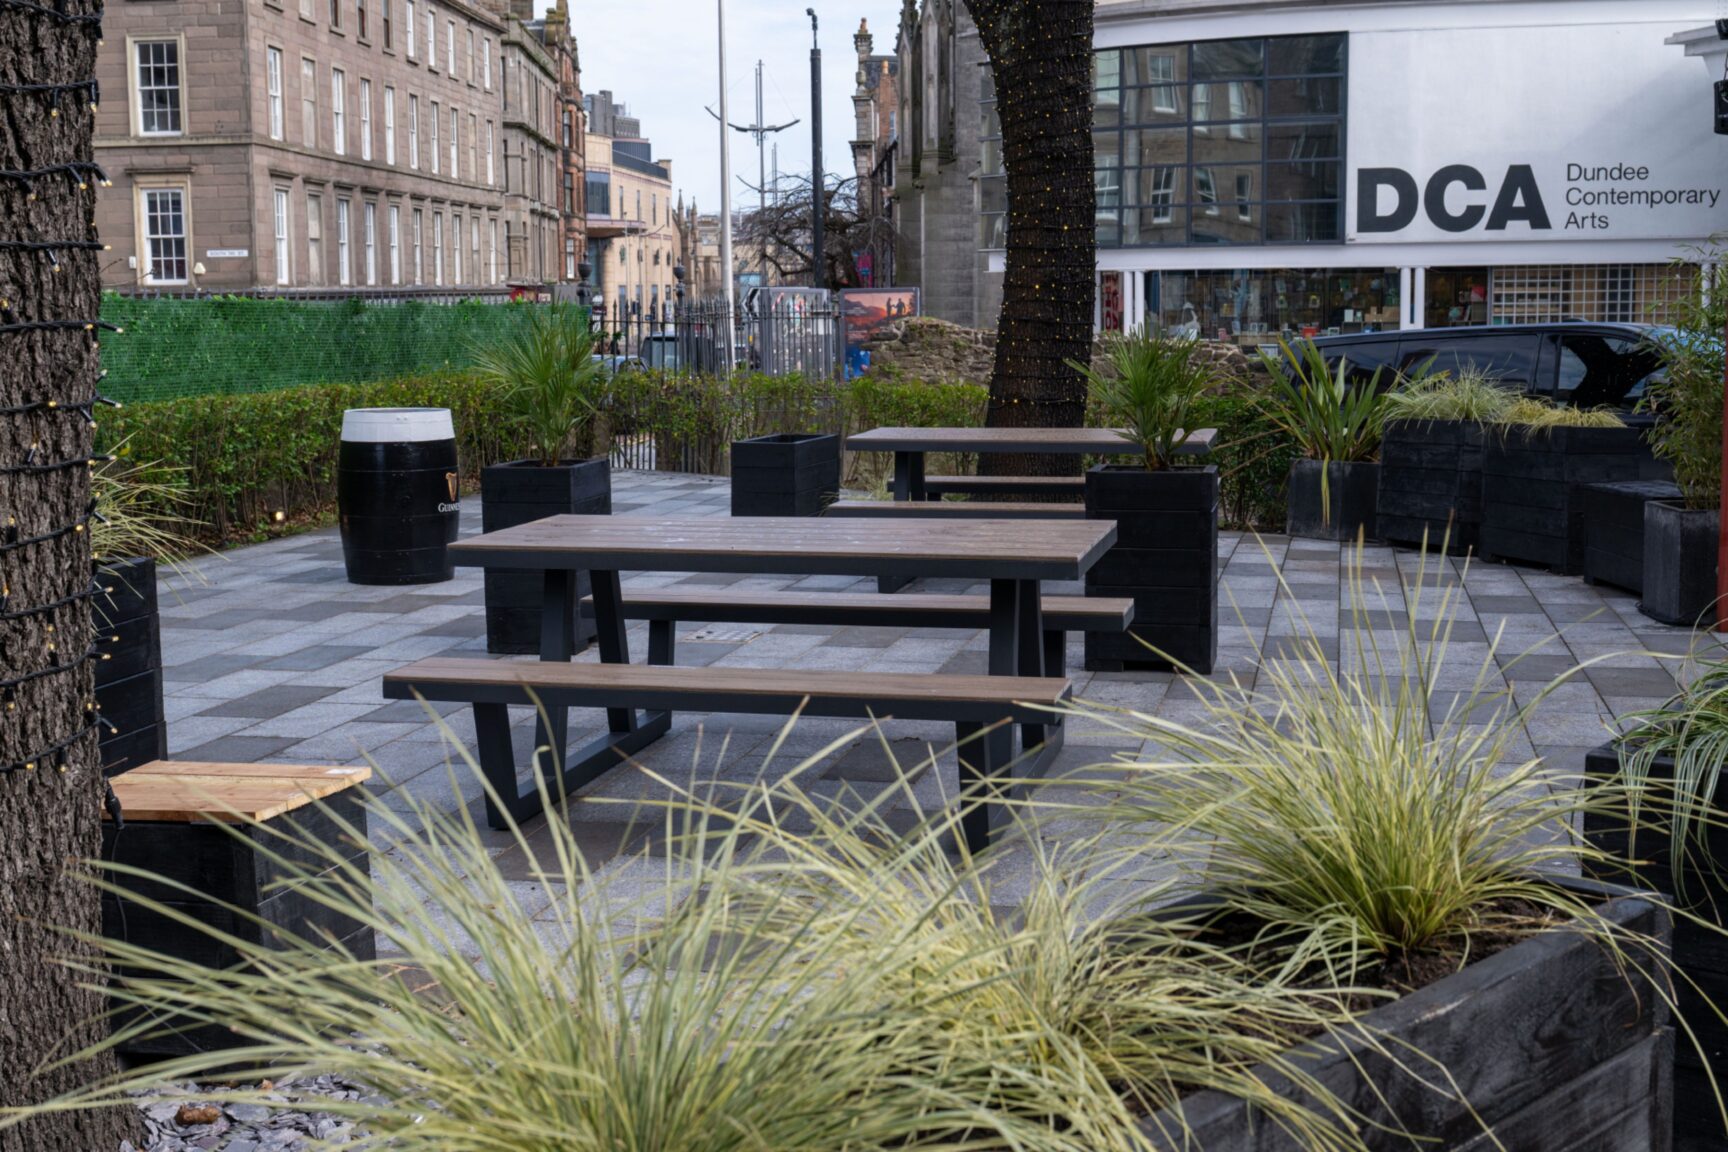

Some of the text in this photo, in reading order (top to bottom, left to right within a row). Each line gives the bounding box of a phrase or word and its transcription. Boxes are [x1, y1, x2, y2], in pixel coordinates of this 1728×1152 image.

[1567, 163, 1649, 181] Dundee
[1357, 164, 1552, 232] DCA
[1565, 188, 1721, 208] Contemporary
[1564, 211, 1610, 230] Arts
[437, 502, 462, 513] GUINNES
